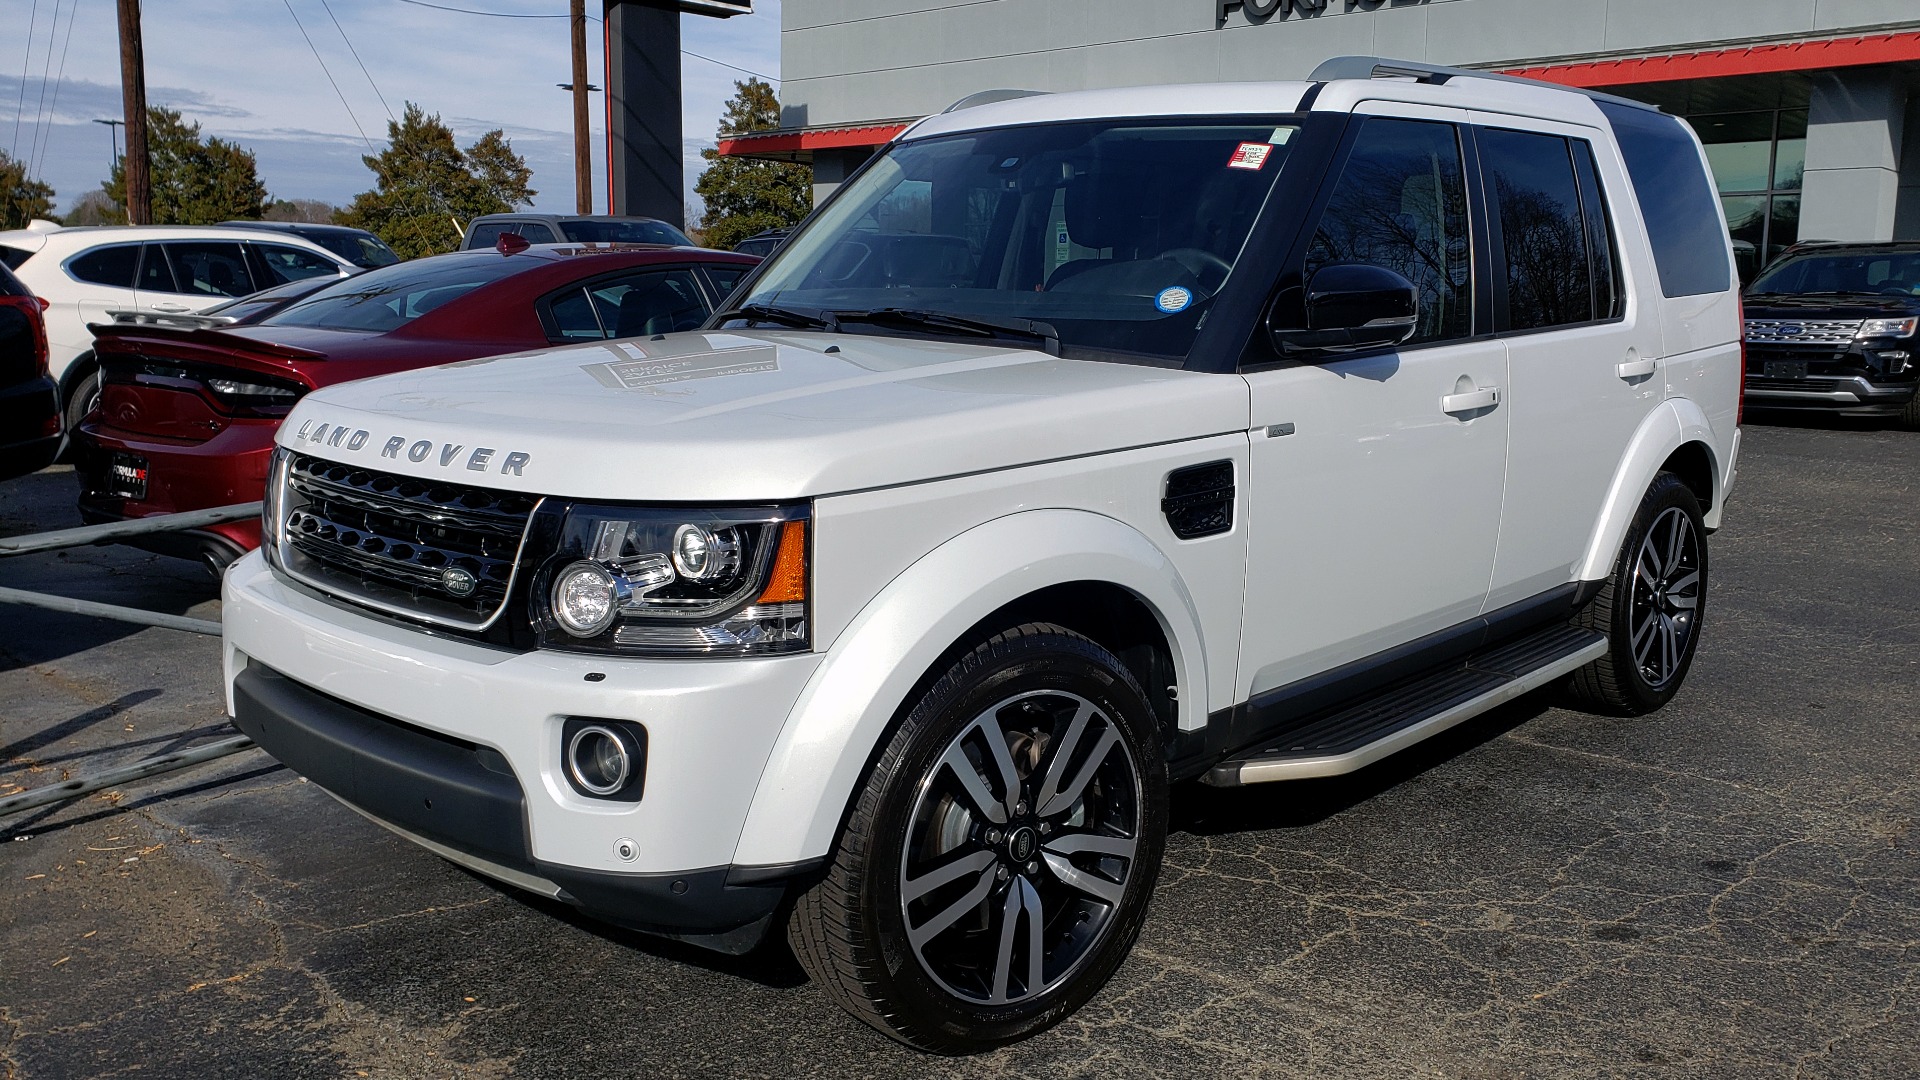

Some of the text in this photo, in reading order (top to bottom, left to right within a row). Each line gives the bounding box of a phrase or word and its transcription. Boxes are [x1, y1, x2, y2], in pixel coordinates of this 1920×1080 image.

[297, 419, 531, 477] LAND ROVER
[447, 580, 469, 591] ROVER
